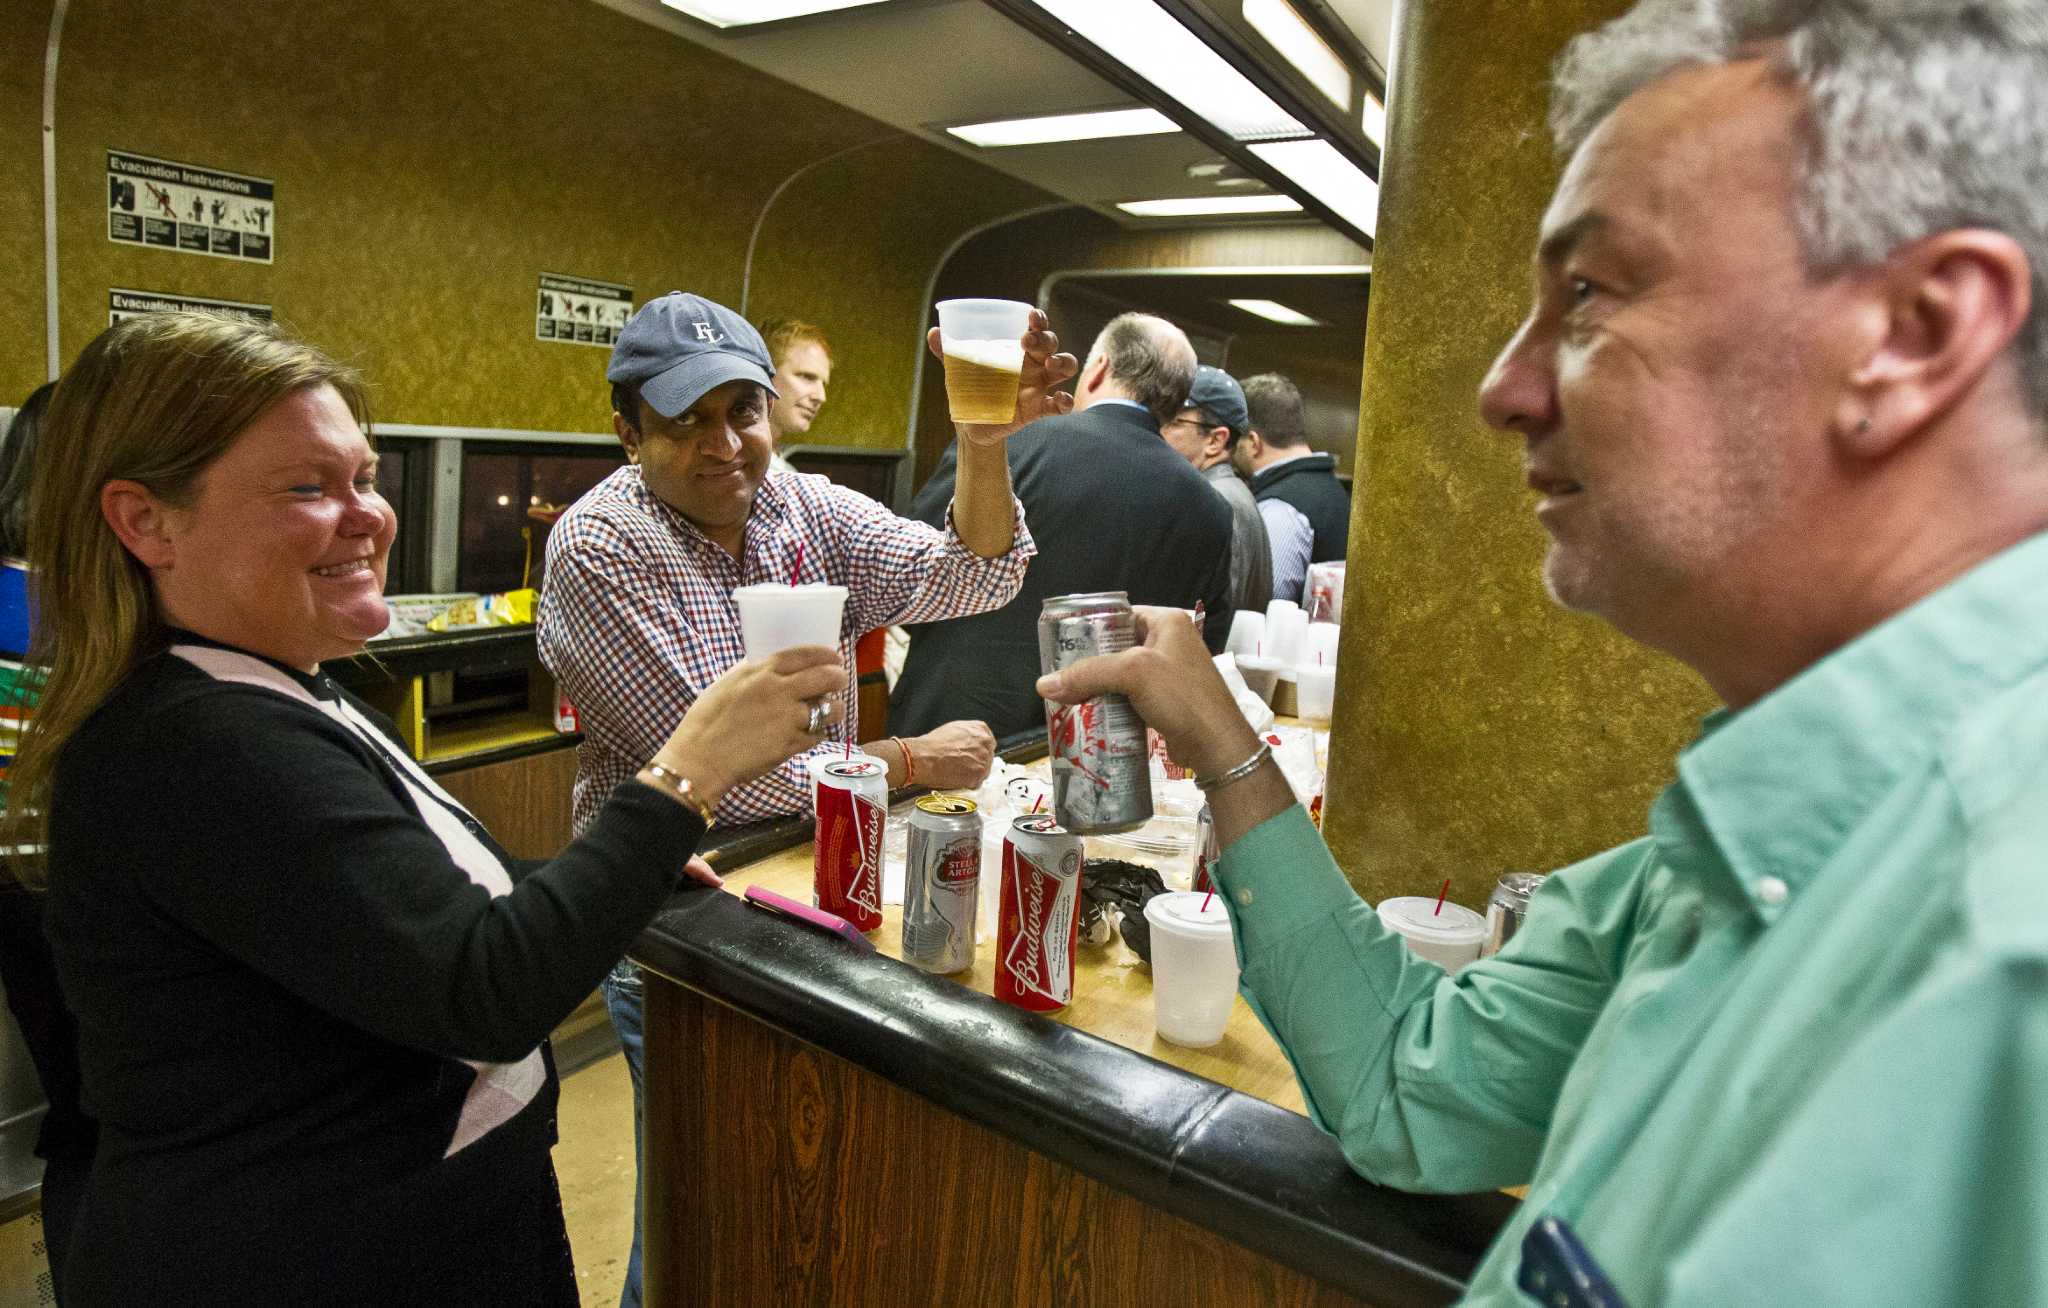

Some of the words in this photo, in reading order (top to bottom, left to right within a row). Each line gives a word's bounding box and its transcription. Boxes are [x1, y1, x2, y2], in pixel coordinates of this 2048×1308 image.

[110, 156, 180, 181] Evacuation
[182, 171, 250, 193] Instructions
[112, 295, 179, 312] Evacuation
[1015, 855, 1045, 996] Budweiser
